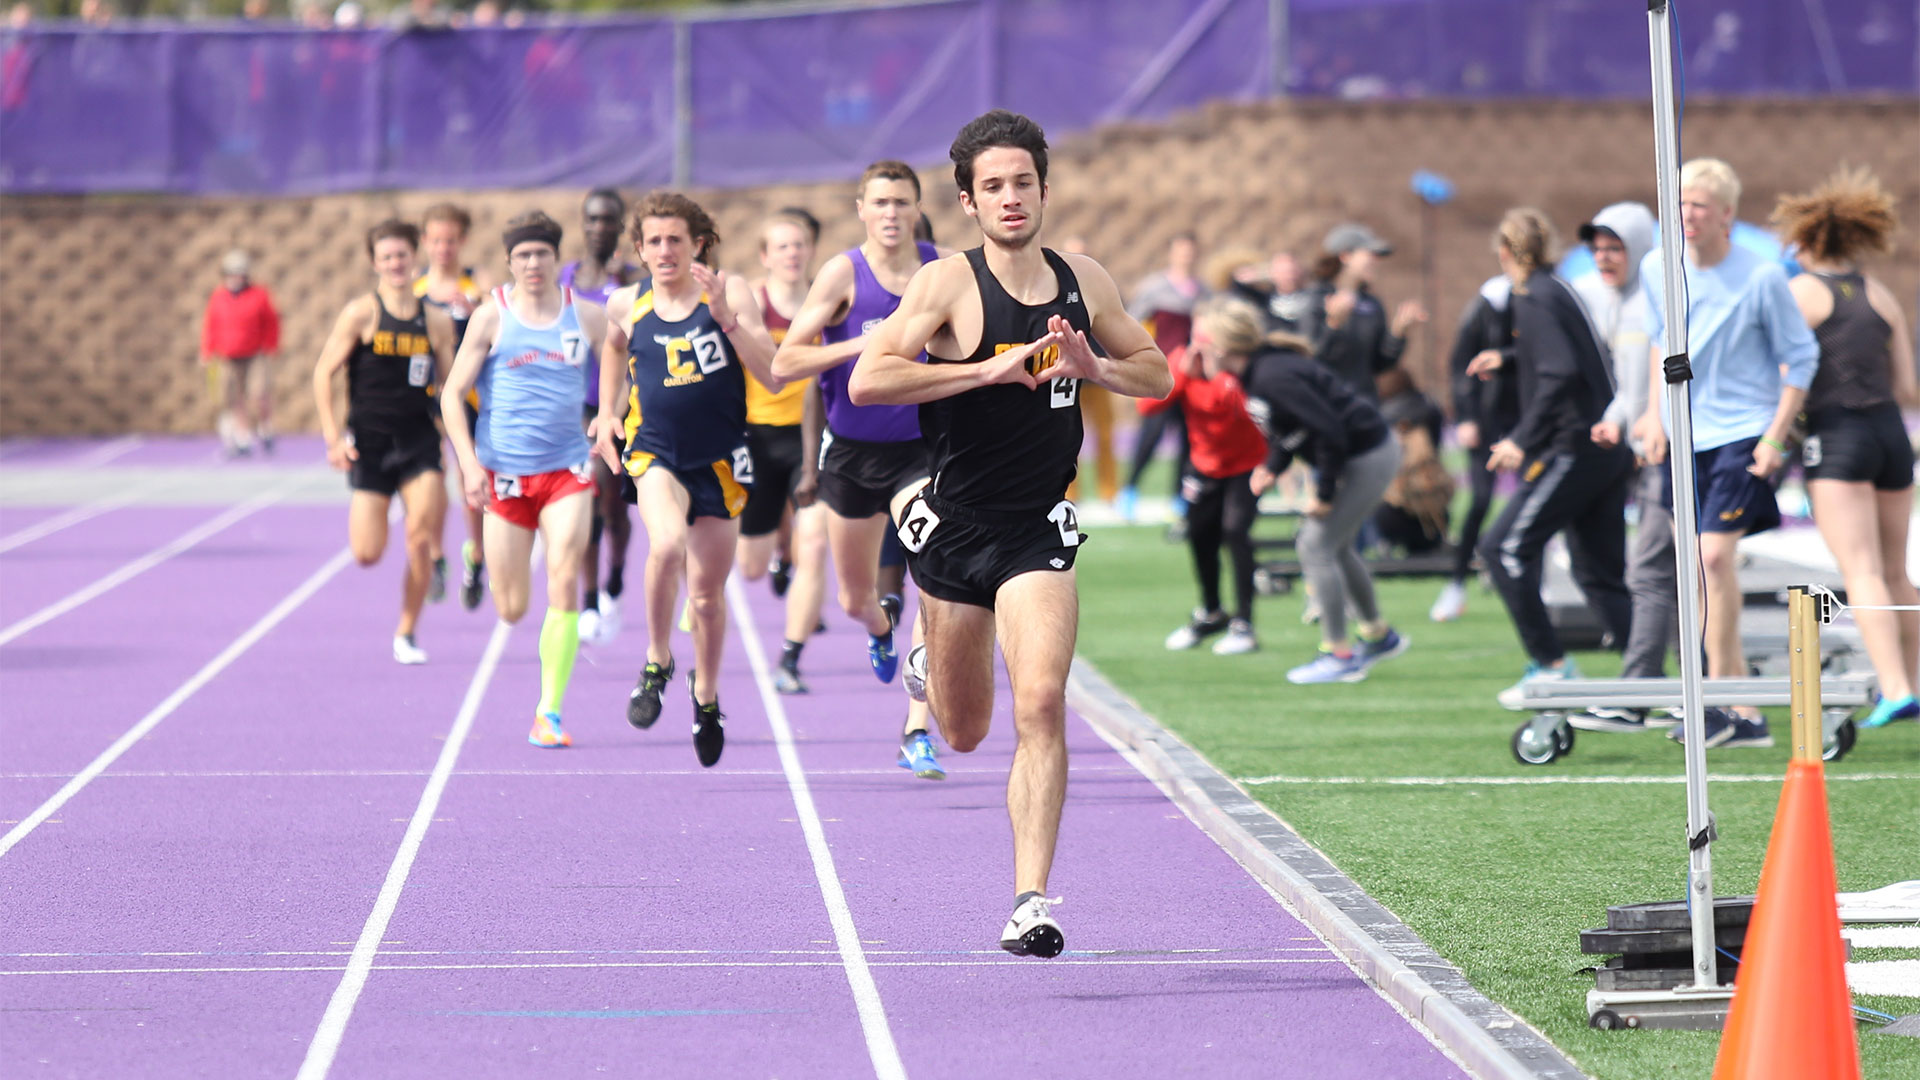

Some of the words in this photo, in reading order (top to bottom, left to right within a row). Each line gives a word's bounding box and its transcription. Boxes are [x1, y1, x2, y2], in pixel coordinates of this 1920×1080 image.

[565, 337, 580, 359] 7
[665, 337, 696, 378] C
[701, 340, 722, 366] 2
[1053, 376, 1074, 399] 4
[738, 453, 753, 478] 2
[499, 478, 514, 495] 7
[907, 516, 929, 547] 4
